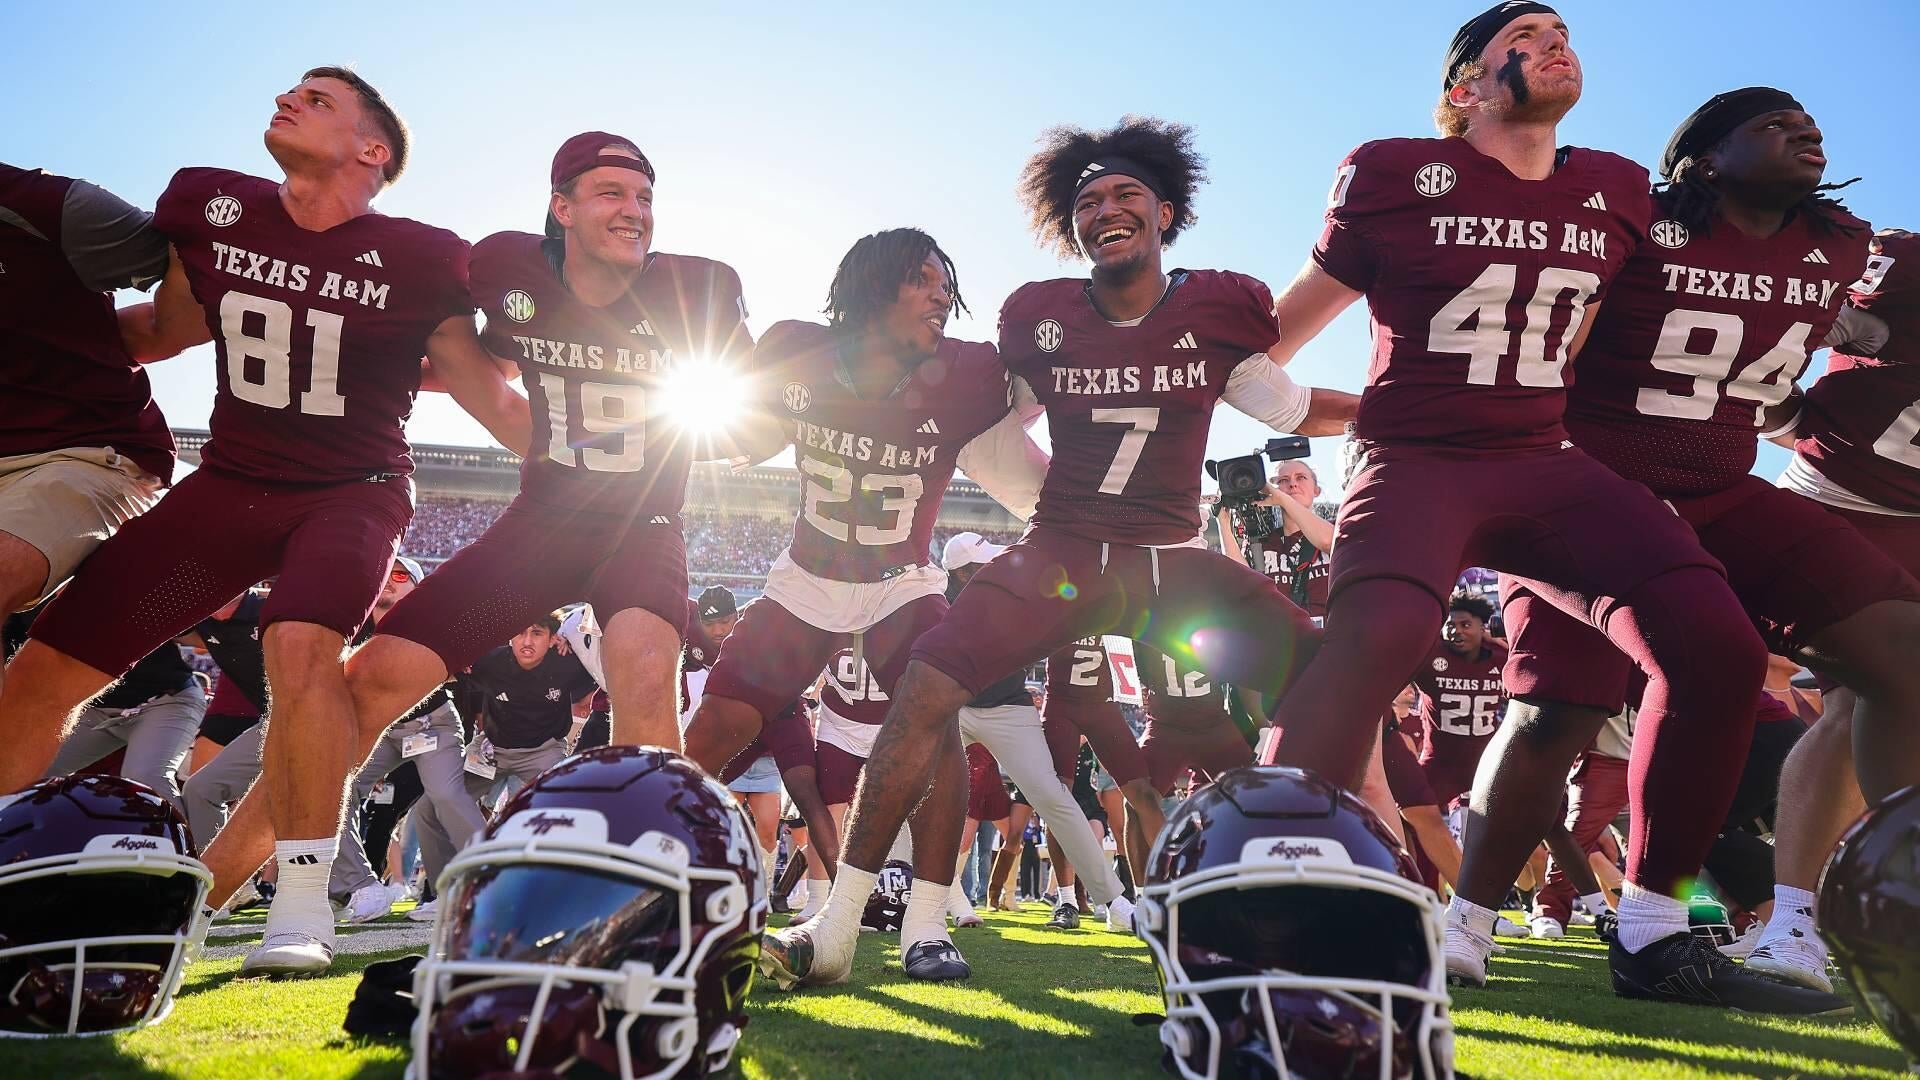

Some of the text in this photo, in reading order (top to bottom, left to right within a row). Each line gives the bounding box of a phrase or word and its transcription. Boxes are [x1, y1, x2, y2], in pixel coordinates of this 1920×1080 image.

[1416, 163, 1455, 196] SEC
[207, 197, 241, 226] SEC
[1430, 216, 1607, 260] TEXAS A&M
[1652, 220, 1688, 248] SEC
[212, 241, 391, 310] TEXAS A&M
[1662, 263, 1840, 310] TEXAS A&M
[506, 290, 534, 322] SEC
[1427, 263, 1601, 388] 40
[220, 290, 346, 417] 81
[512, 335, 673, 374] TEXAS A&M
[1036, 320, 1063, 352] SEC
[1051, 360, 1208, 395] TEXAS A&M
[1635, 308, 1814, 428] 94
[784, 383, 811, 412] SEC
[539, 371, 646, 473] 19
[792, 418, 938, 469] TEXAS A&M
[1091, 407, 1161, 496] 7
[801, 454, 924, 546] 23
[1069, 649, 1103, 687] 2
[1435, 677, 1480, 691] TEXAS
[1440, 693, 1499, 737] 26
[112, 836, 159, 851] Aggies
[1267, 840, 1324, 860] Aggies
